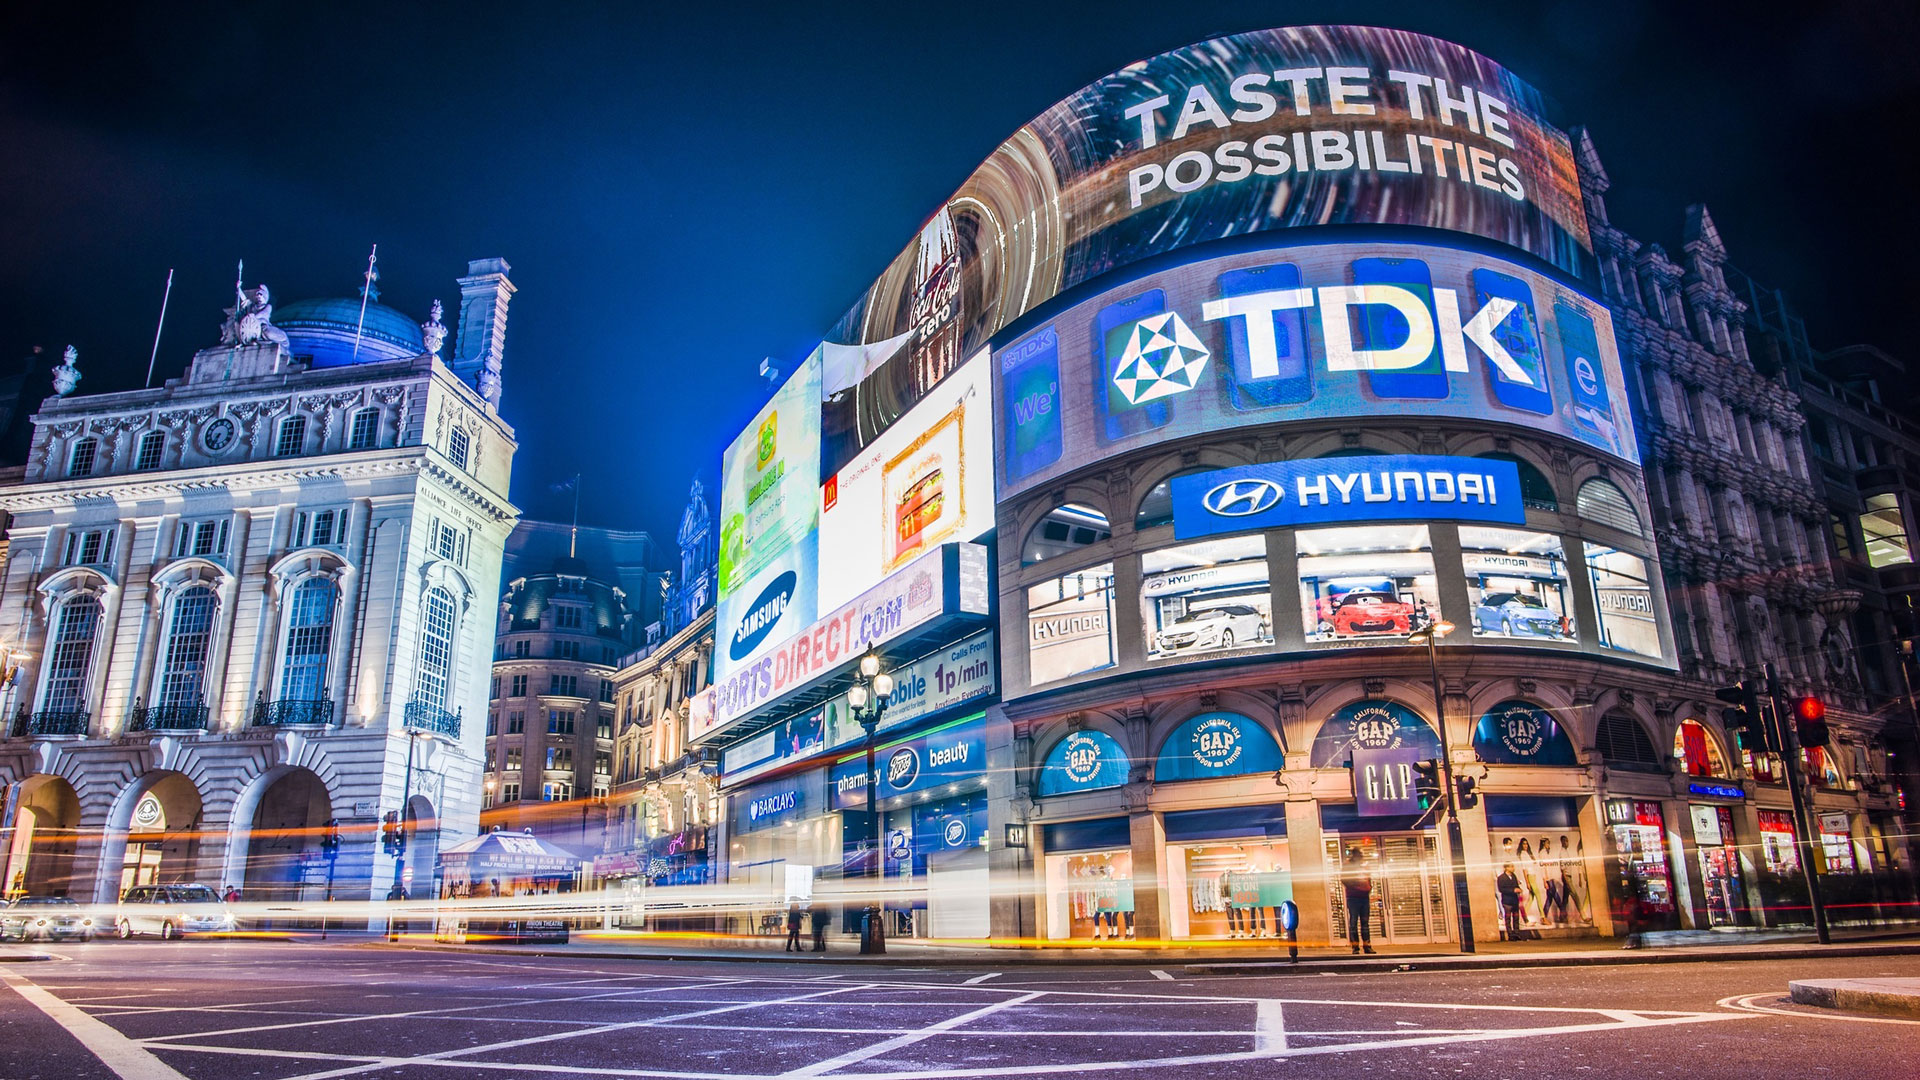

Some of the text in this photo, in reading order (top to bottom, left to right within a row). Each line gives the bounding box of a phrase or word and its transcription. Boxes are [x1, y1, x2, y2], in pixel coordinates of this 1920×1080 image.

[1124, 66, 1515, 150] TASTE THE
[1129, 130, 1526, 209] POSSIBILITIES
[920, 304, 951, 343] zero
[1202, 285, 1535, 386] TDK
[1014, 330, 1052, 361] TDK
[1298, 470, 1497, 506] HYUNDAI
[421, 486, 482, 531] ALLIANCE LIFE OFFICE
[1484, 556, 1529, 568] HYUNDAI
[1168, 570, 1218, 586] HYUNDAI
[1601, 593, 1652, 613] HYUNDAI
[737, 591, 787, 643] SAMSUNG
[1033, 614, 1105, 640] HYUNDAI
[951, 640, 987, 661] Calls From
[935, 683, 993, 711] Anytime Everyday
[1358, 721, 1393, 741] GAP
[1390, 717, 1400, 730] USA
[1508, 720, 1536, 739] GAP
[1201, 732, 1234, 752] GAP
[1207, 749, 1228, 757] 1969
[930, 741, 969, 768] beauty
[1071, 749, 1095, 769] GAP
[1193, 746, 1242, 768] LONDON EDITION
[888, 753, 912, 782] Boots
[1365, 763, 1411, 801] GAP
[758, 791, 795, 815] BARCLAYS
[1608, 804, 1629, 820] GAP
[1232, 881, 1259, 891] IS ON!
